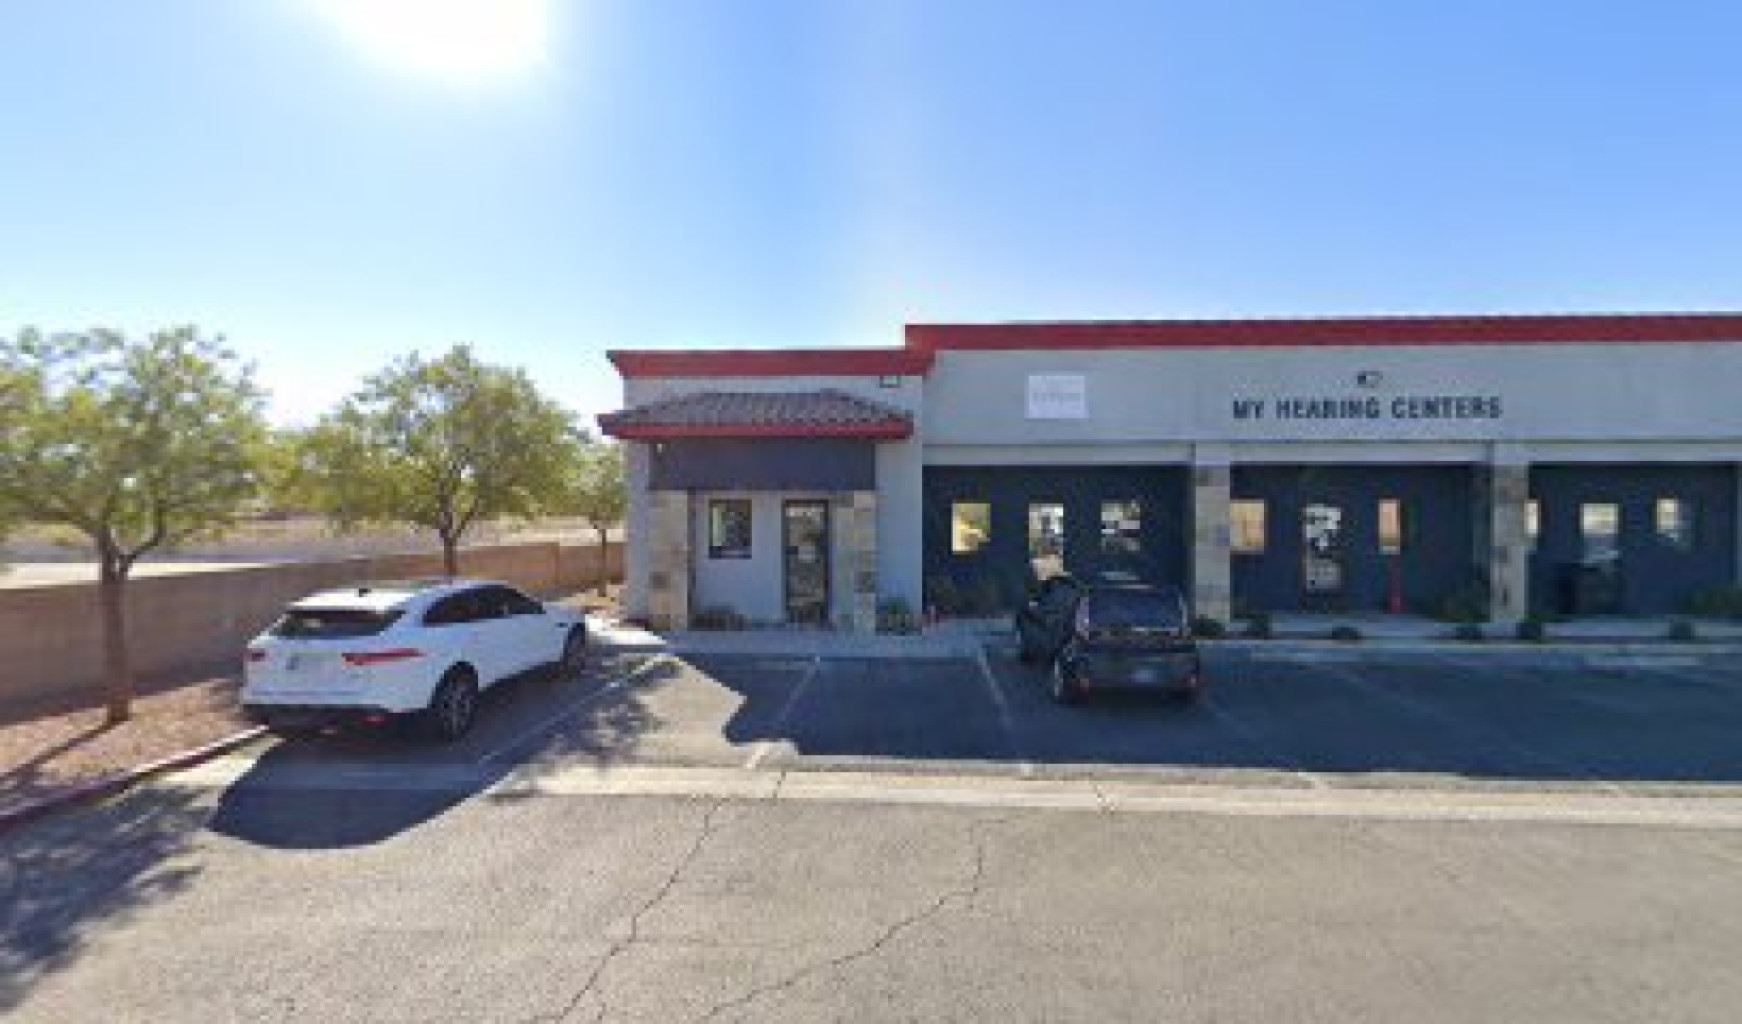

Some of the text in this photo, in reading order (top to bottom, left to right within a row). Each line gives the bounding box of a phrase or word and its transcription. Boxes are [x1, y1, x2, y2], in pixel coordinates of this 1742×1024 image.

[1233, 396, 1502, 419] MY HEARING CENTERS
